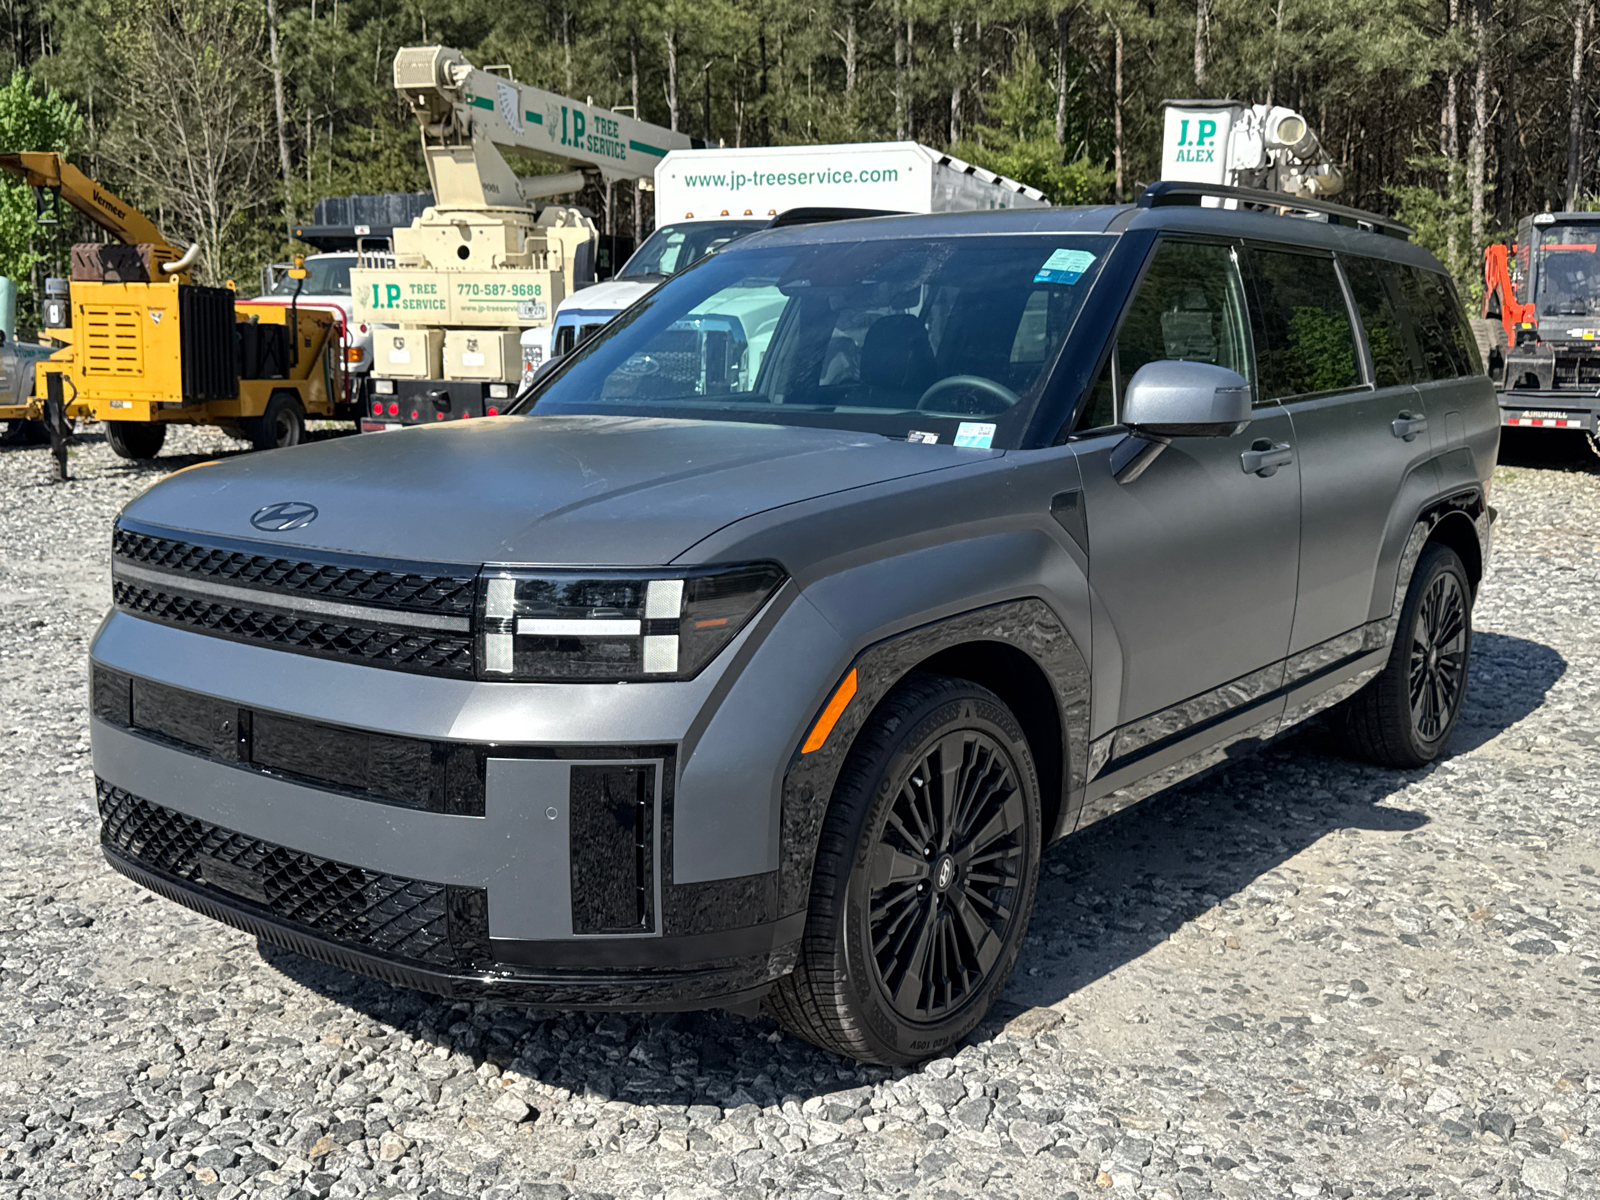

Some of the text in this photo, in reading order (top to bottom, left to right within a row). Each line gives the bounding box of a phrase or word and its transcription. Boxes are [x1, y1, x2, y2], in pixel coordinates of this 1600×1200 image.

[561, 106, 585, 150] J.P.
[594, 116, 619, 138] TREE
[1177, 119, 1216, 147] J.P.
[587, 134, 626, 160] SERVICE
[1175, 149, 1215, 163] ALEX
[684, 167, 899, 191] www.jp-treeservice.com
[93, 188, 126, 220] Vermeer
[372, 283, 401, 309] J.P.
[409, 284, 437, 294] TREE
[457, 283, 542, 296] 770-587-9688
[402, 298, 446, 310] SERVICE
[855, 776, 891, 869] KUMHO
[909, 1040, 931, 1050] 105V
